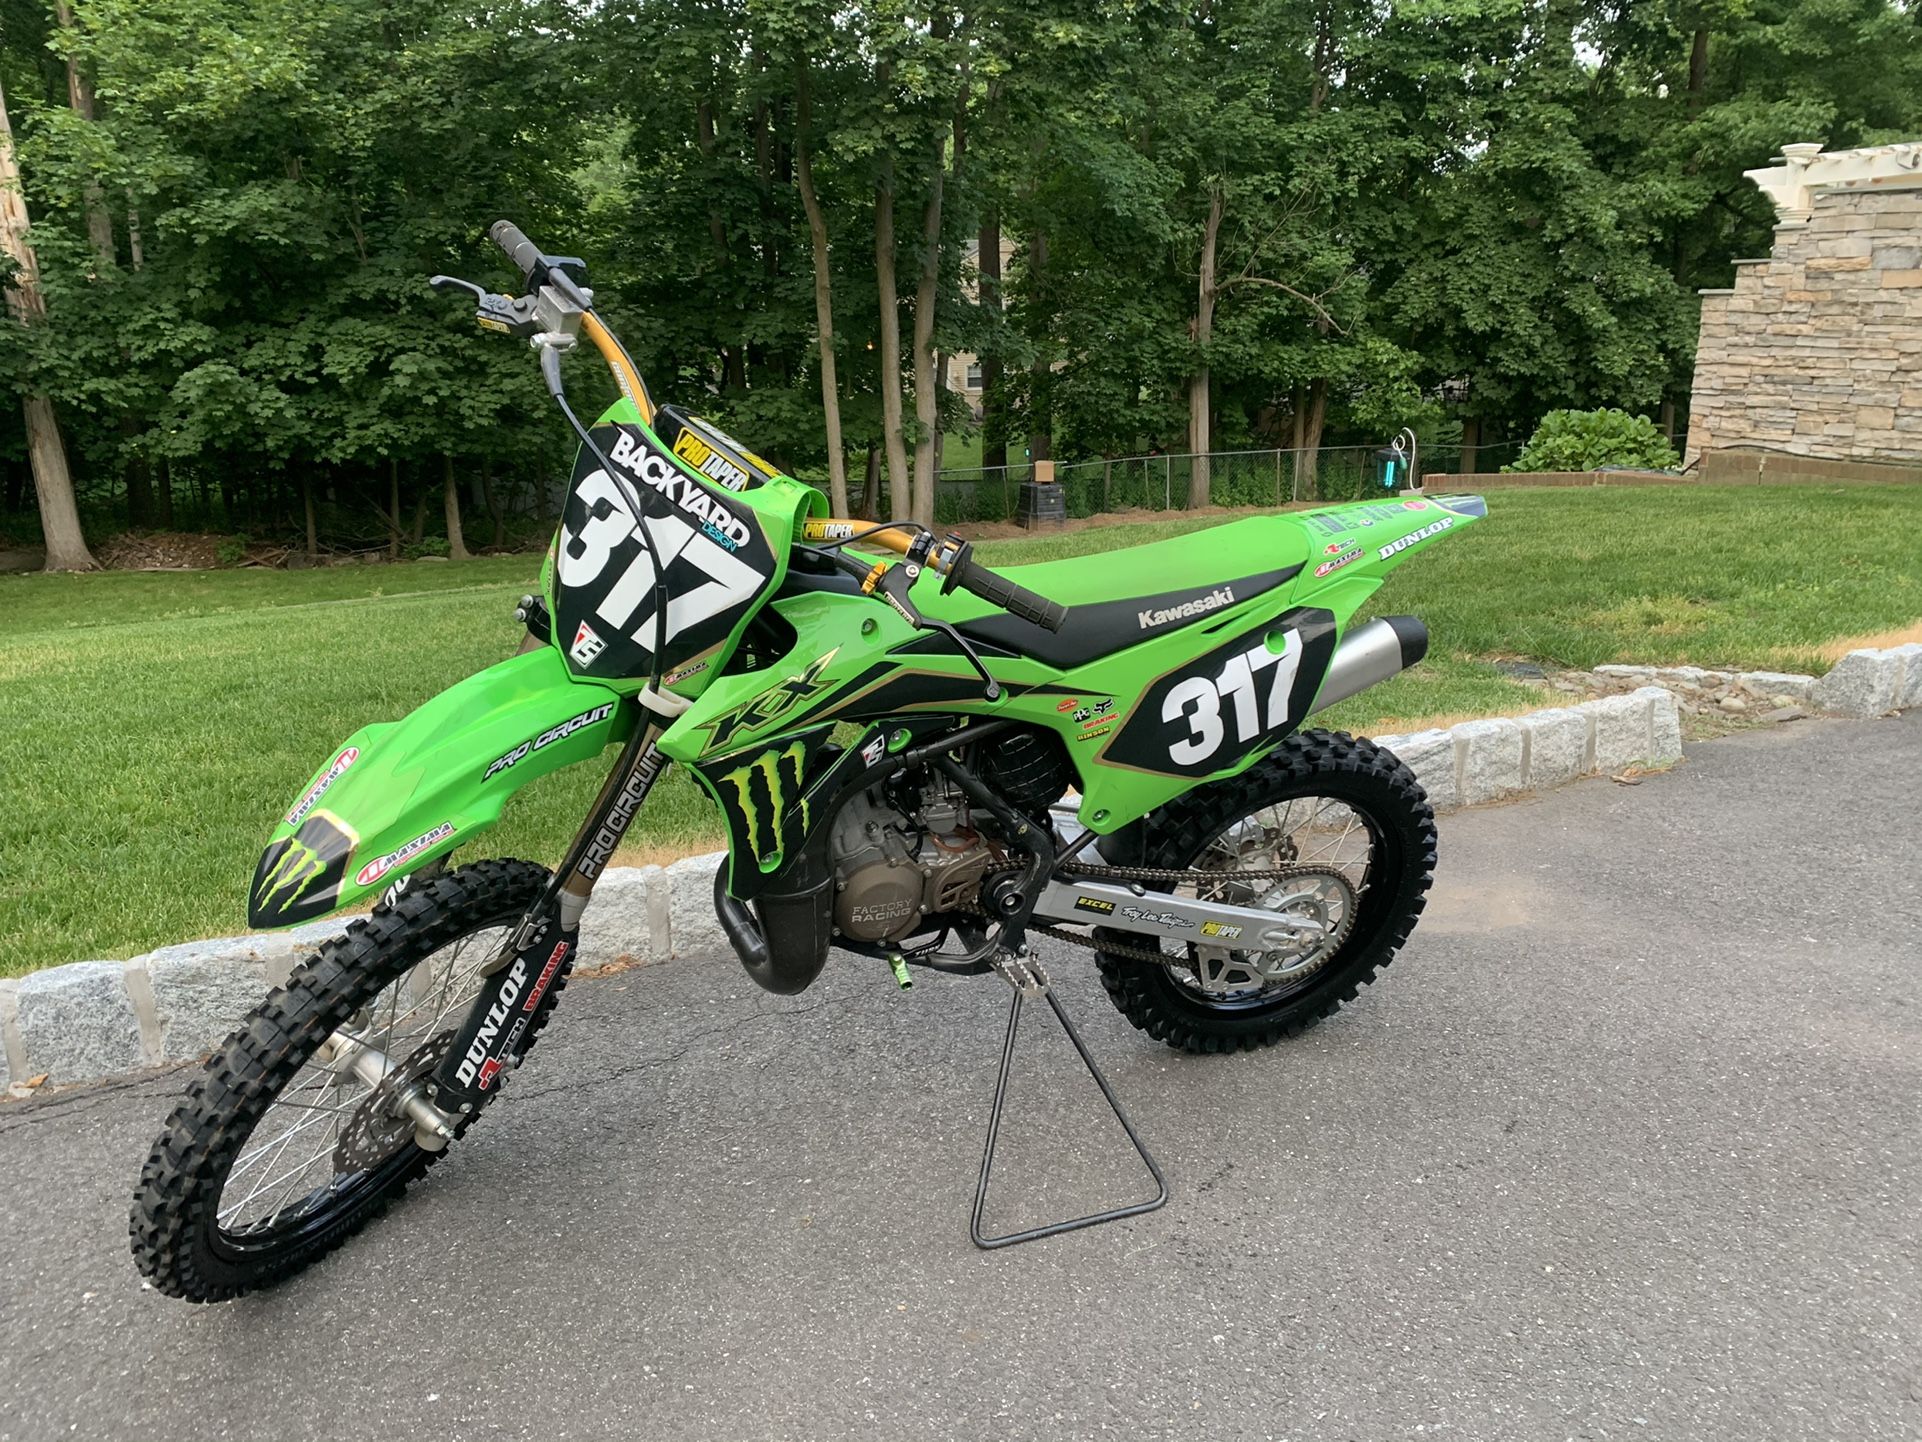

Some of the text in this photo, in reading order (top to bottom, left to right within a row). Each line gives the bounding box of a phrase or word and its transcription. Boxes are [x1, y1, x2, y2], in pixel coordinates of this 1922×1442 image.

[610, 426, 750, 547] BACKYARD
[676, 432, 748, 492] PROTAPER
[702, 520, 738, 552] DESIGN
[804, 523, 855, 539] PROTAPER
[1378, 517, 1454, 560] DUNLOP
[557, 469, 766, 654] 317
[1138, 587, 1235, 629] Kawasaki
[692, 645, 842, 759] KX
[1162, 628, 1303, 766] 317
[483, 703, 614, 780] PRO CIRCUIT
[577, 741, 664, 880] PRO CIRCUIT
[851, 907, 912, 923] RACING
[852, 899, 912, 915] FACTORY
[1078, 897, 1114, 911] EXCEL
[1121, 906, 1143, 922] Troy
[1140, 910, 1159, 922] Lee
[522, 940, 570, 1012] BRAKING
[455, 957, 528, 1089] DUNLOP
